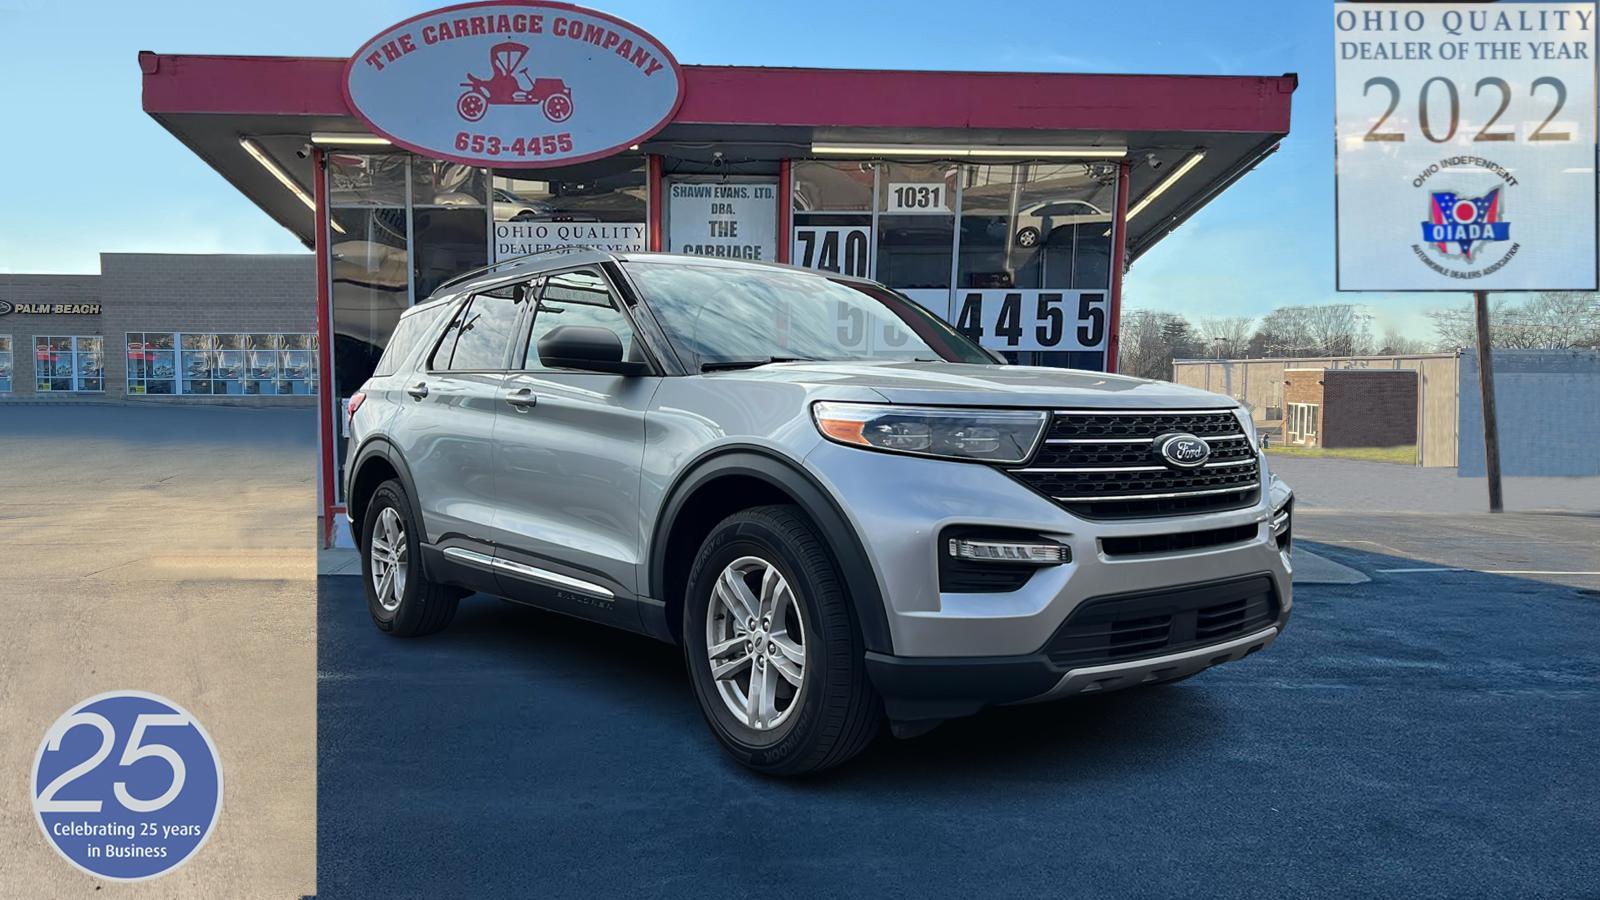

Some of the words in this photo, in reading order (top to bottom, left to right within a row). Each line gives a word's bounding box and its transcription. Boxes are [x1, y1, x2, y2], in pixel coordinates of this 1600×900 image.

[1336, 10, 1424, 31] OHIO
[1442, 10, 1592, 36] QUALITY
[365, 33, 417, 71] THE
[422, 14, 544, 45] CARRIAGE
[552, 16, 664, 77] COMPANY
[1340, 42, 1433, 60] DEALER
[1438, 42, 1469, 60] OF
[1475, 42, 1522, 60] THE
[1527, 41, 1589, 60] YEAR
[1362, 76, 1571, 143] 2022
[455, 132, 573, 156] 653-4455
[1412, 163, 1440, 188] OHIO
[1439, 155, 1519, 187] INDEPENDENT
[673, 185, 711, 198] SHAWN
[754, 187, 775, 199] LTD.
[894, 186, 940, 208] 1031
[711, 203, 736, 215] DBA.
[497, 226, 548, 239] OHIO
[557, 226, 644, 241] QUALITY
[708, 220, 738, 237] THE
[1432, 224, 1495, 240] OIADA
[683, 244, 762, 260] CARRIAGE
[797, 229, 868, 278] 740
[1449, 270, 1482, 279] DEALERS
[1482, 242, 1520, 276] ASSOCIATION
[14, 304, 51, 314] PALM
[54, 304, 100, 314] BEACH
[956, 293, 1105, 347] 4455
[1176, 441, 1203, 459] Ford
